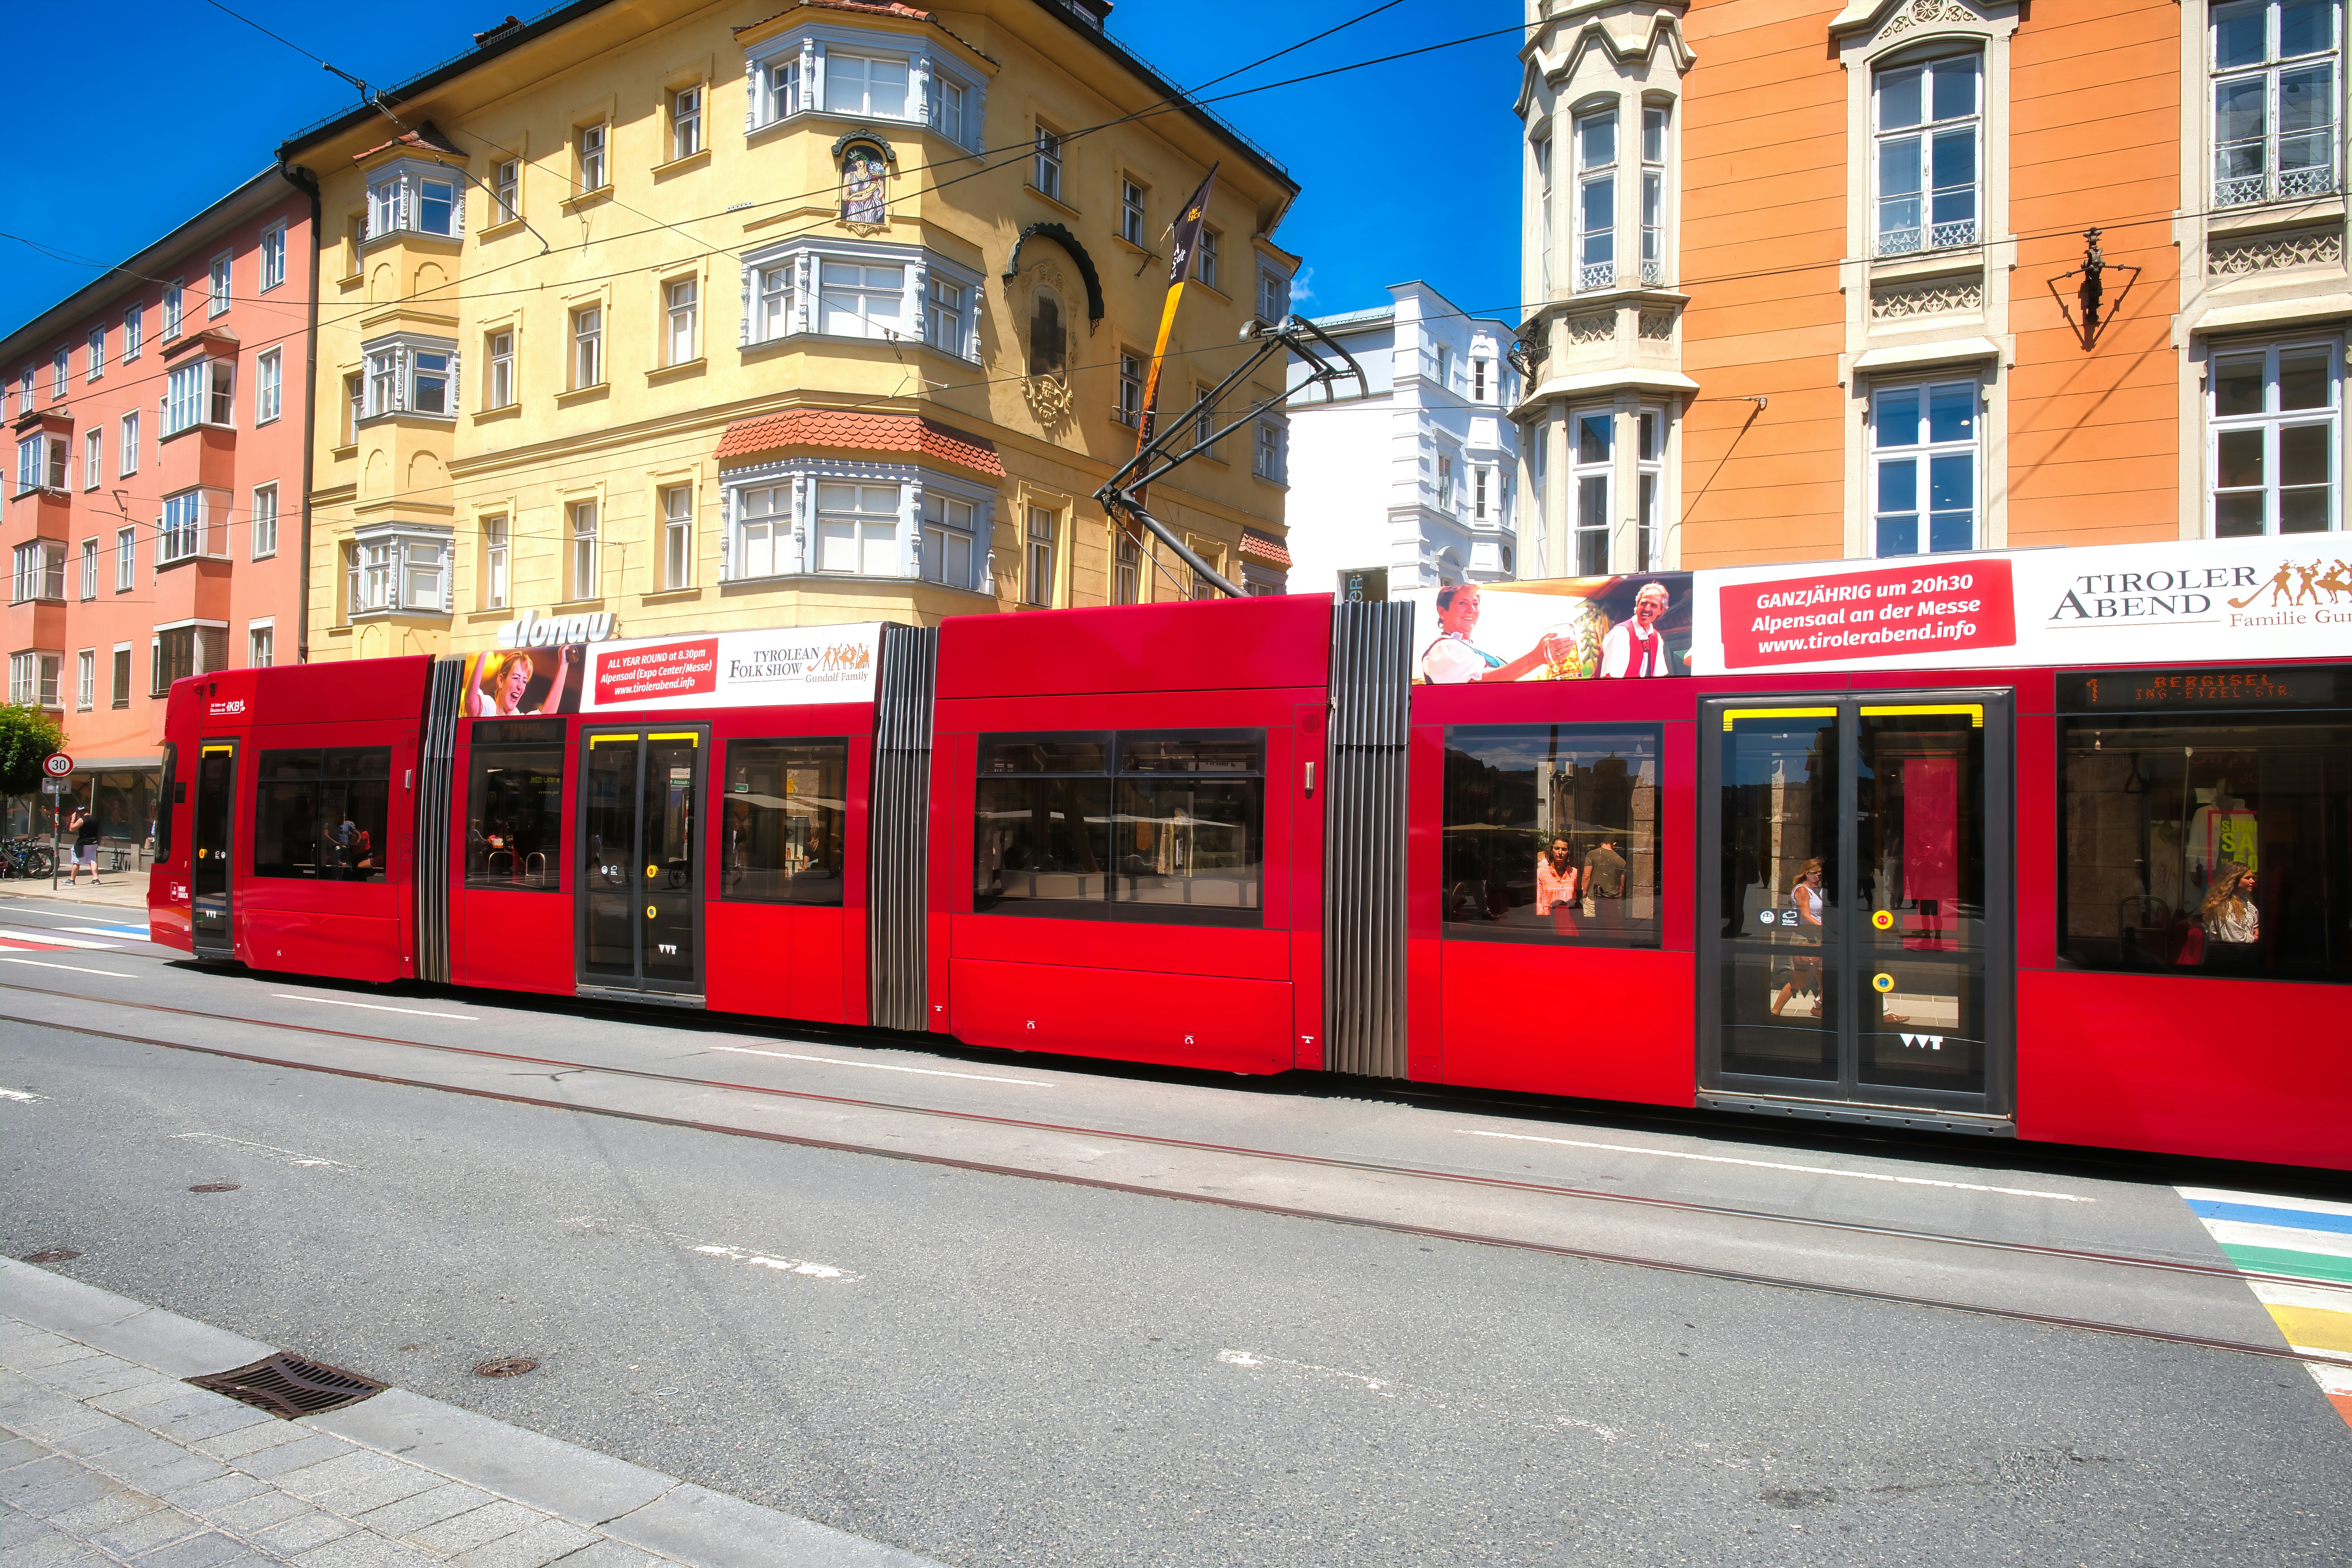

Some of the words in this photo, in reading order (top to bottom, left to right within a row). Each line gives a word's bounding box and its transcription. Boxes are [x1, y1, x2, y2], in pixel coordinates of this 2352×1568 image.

[2076, 566, 2260, 594] TIROLER
[1756, 583, 1871, 609] GANZJÄHRIG
[1876, 582, 1906, 596] um
[1911, 574, 1973, 595] 20h30
[2048, 588, 2211, 620] ABEND
[1751, 609, 1845, 633] Alpensaal
[1850, 607, 1875, 623] an
[1879, 603, 1913, 620] der
[1917, 598, 1981, 617] Messe
[2229, 612, 2307, 627] Familie
[497, 610, 617, 648] donau
[1758, 620, 1976, 653] www.tirolerabend.info
[608, 660, 620, 669] ALL
[623, 656, 640, 667] YEAR
[642, 652, 667, 664] ROUND
[669, 651, 677, 661] at
[678, 649, 705, 660] 8.30pm
[754, 647, 820, 662] TYROLEAN
[600, 669, 635, 685] Alpensaal
[637, 668, 657, 680] (Expo
[658, 659, 712, 676] Center/Messe)
[729, 660, 763, 678] FOLK
[766, 663, 802, 676] SHOW
[806, 672, 839, 683] Gundolf
[841, 671, 868, 681] Family
[614, 677, 695, 695] www.tirolerabend.info
[2087, 679, 2097, 701] 1
[2154, 674, 2272, 688] BERGISEL
[52, 760, 66, 770] 30
[658, 944, 677, 954] VVT
[1900, 1033, 1943, 1050] VVT
